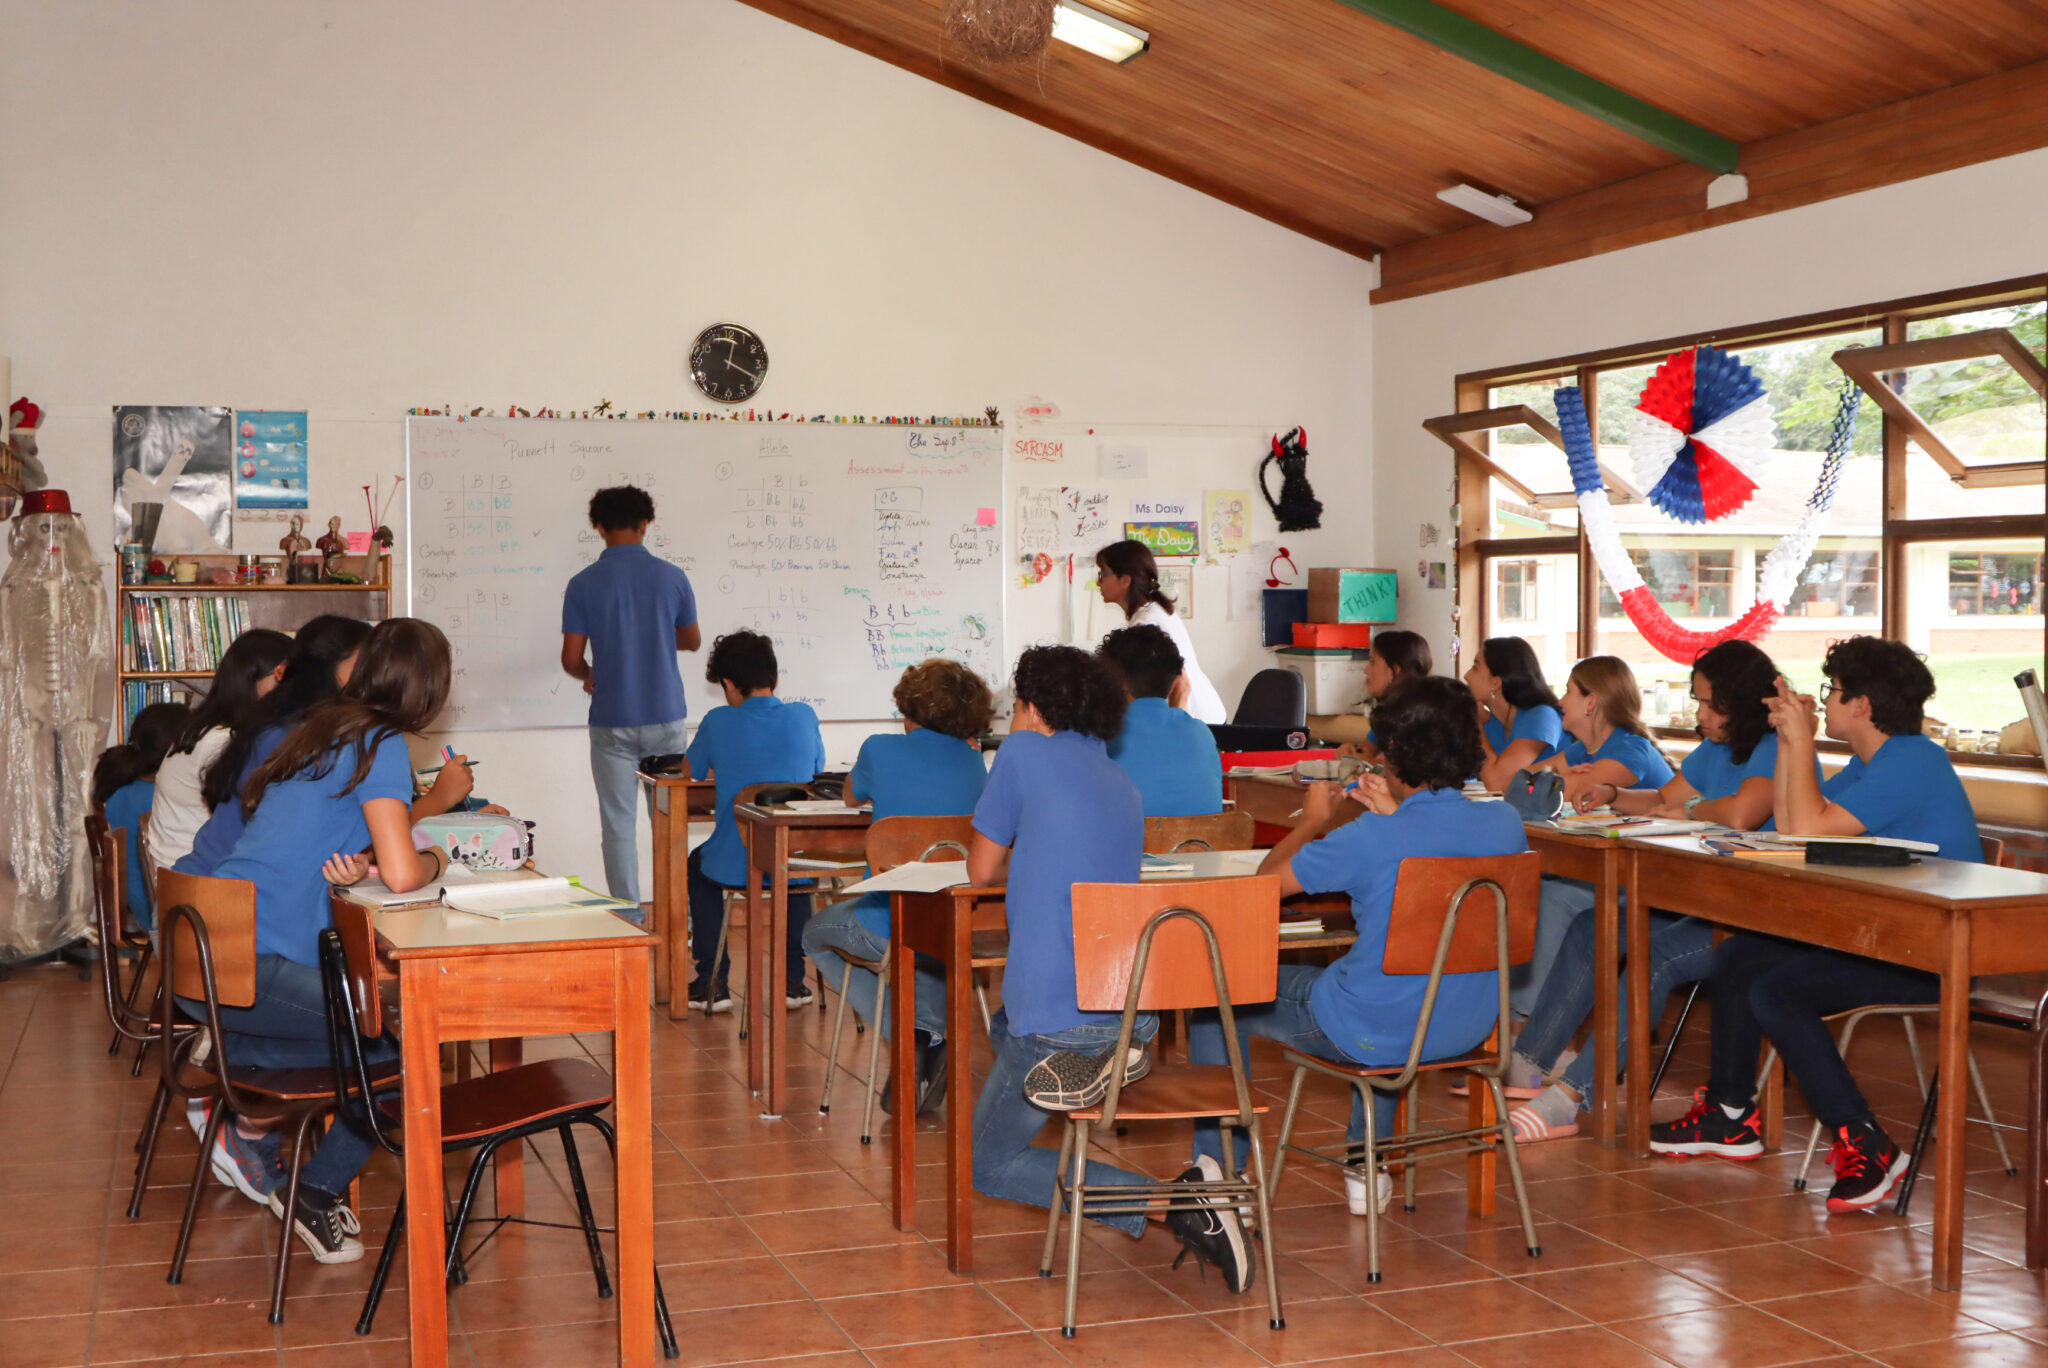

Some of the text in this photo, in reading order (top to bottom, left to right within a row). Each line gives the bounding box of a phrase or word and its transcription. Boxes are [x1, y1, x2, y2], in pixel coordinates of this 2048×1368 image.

[503, 439, 614, 461] Punnett Square
[1015, 439, 1063, 458] SARCASM
[1135, 503, 1185, 516] Ms. Daisy
[950, 533, 980, 551] Oscar
[1156, 526, 1195, 553] Daisy
[869, 604, 879, 620] B
[902, 603, 911, 618] b
[866, 628, 885, 642] BB
